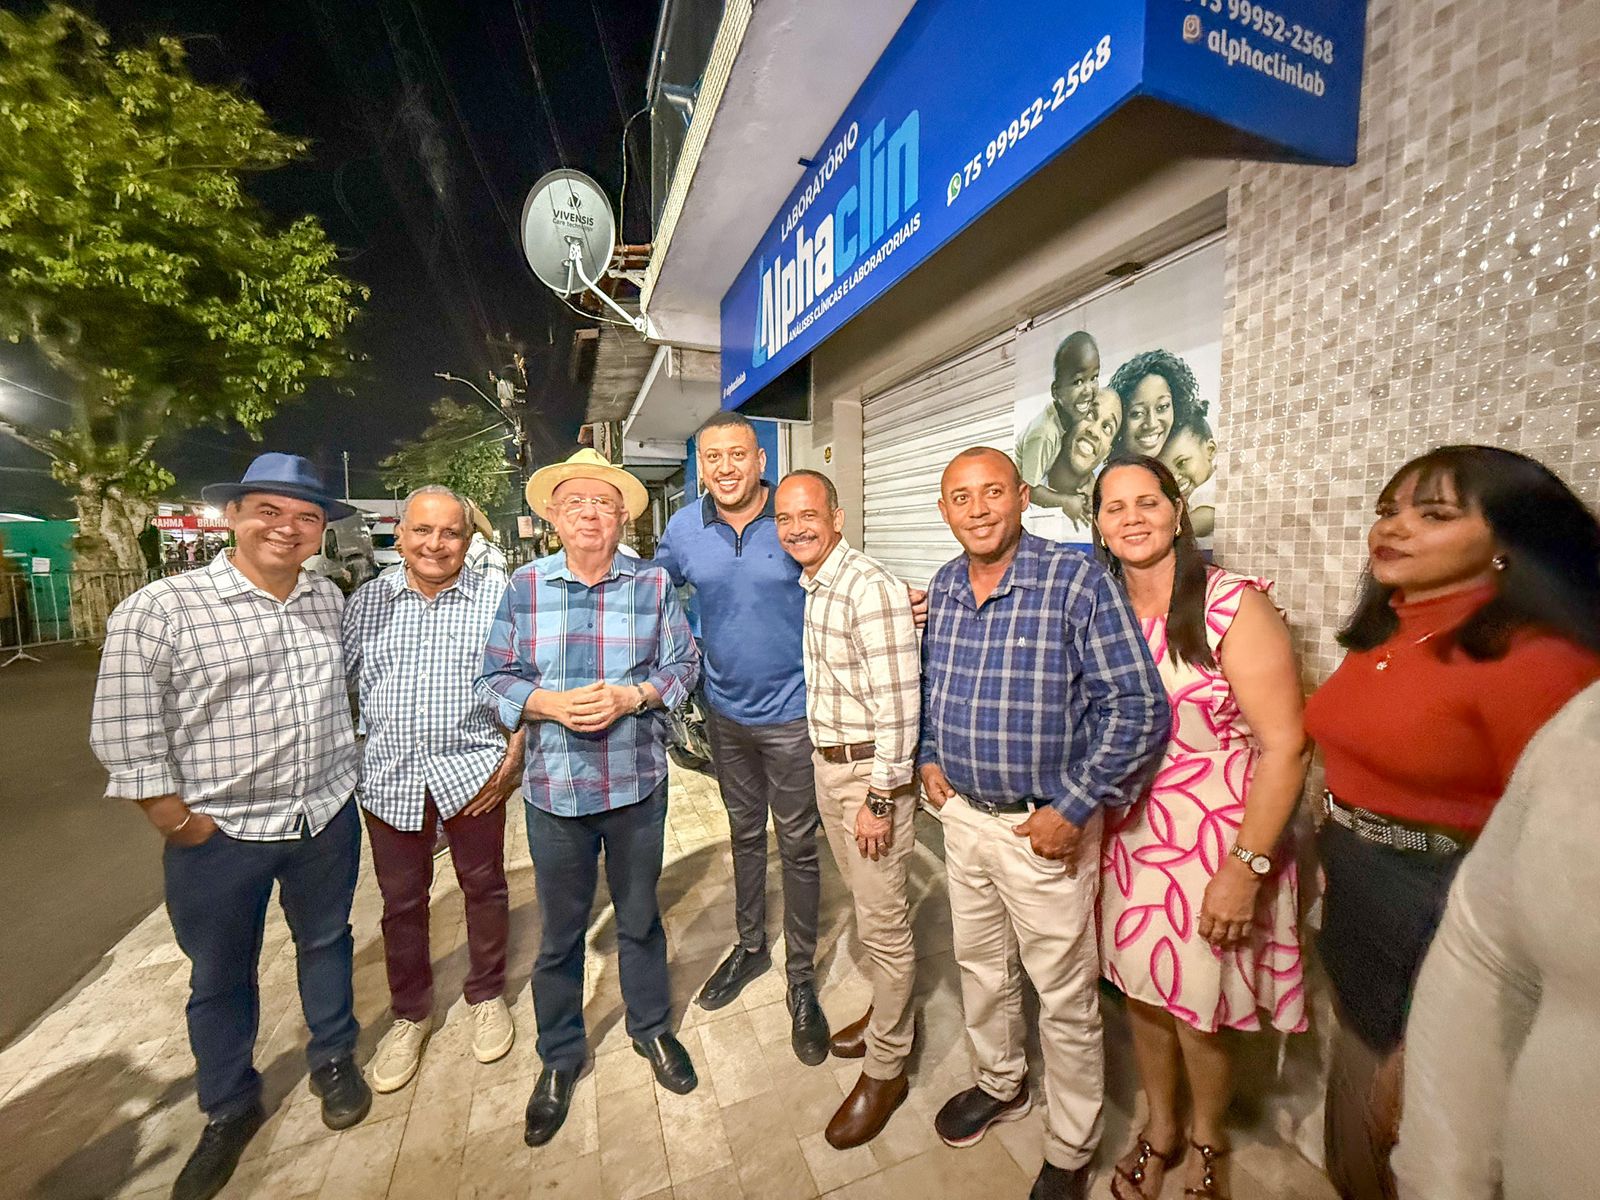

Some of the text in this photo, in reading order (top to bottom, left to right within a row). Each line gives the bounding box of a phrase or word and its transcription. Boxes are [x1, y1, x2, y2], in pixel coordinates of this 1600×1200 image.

[1200, 0, 1334, 64] 5 99952-2568
[1207, 28, 1325, 97] alphaclinlab
[962, 34, 1112, 188] 75 99952-2568
[781, 121, 859, 243] LABORATÓRIO
[553, 209, 594, 226] VIVENSIS
[788, 212, 921, 343] ANÁLISES CLÍNICAS E LABORATORIAIS
[151, 518, 229, 528] RAHMA BRAHM
